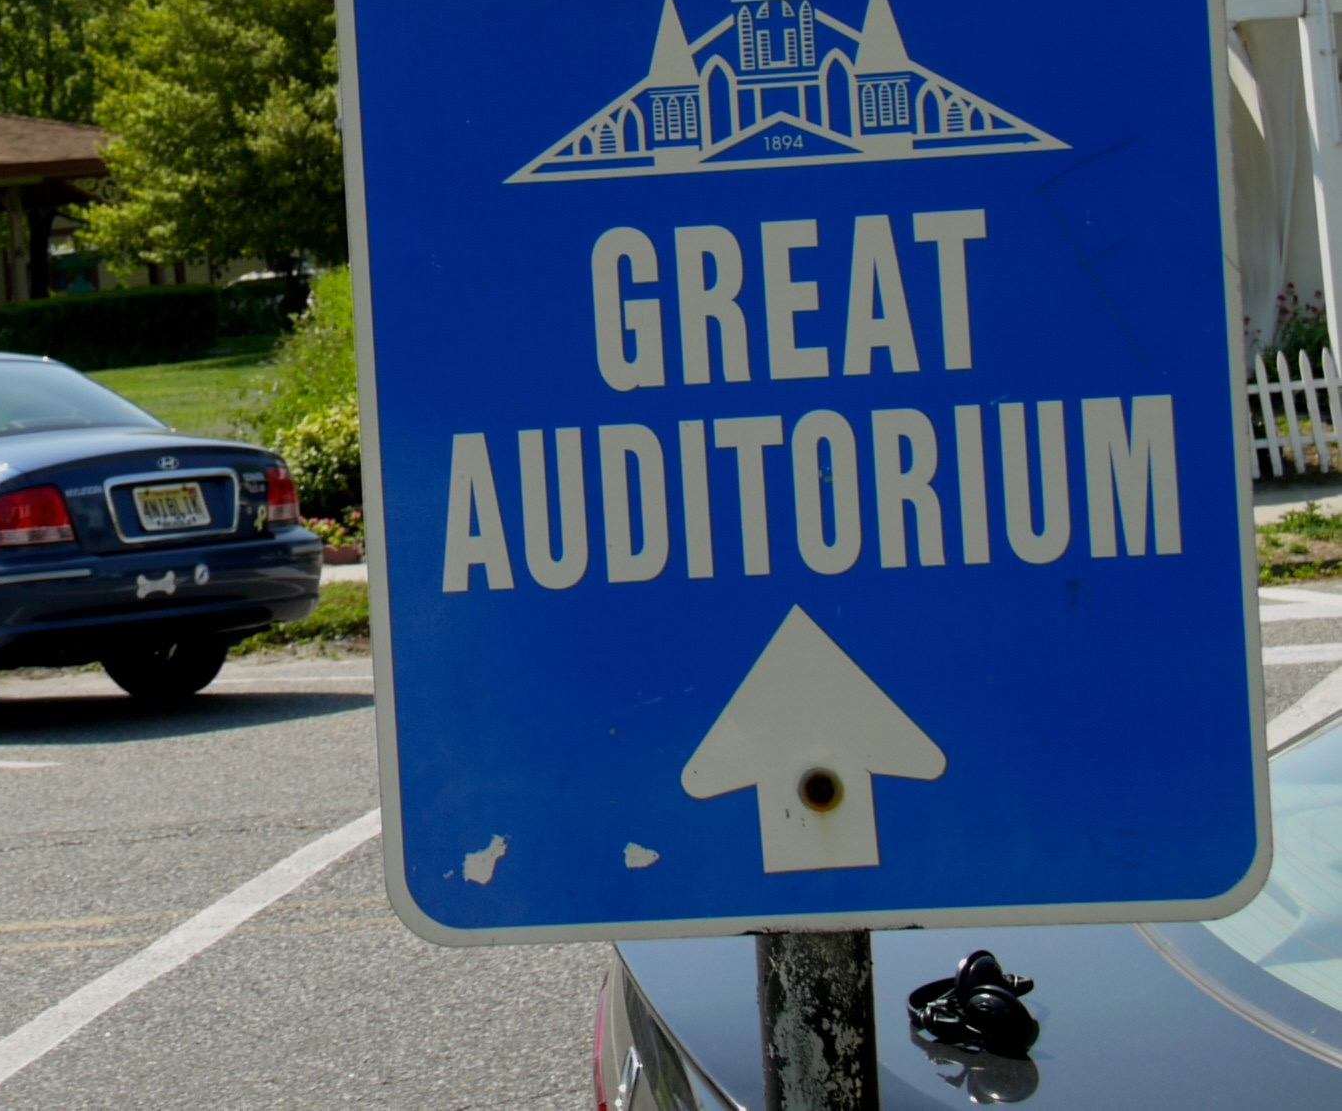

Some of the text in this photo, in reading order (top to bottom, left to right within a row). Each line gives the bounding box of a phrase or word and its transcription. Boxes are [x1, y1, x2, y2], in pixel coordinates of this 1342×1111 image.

[762, 134, 804, 152] 1894
[591, 209, 987, 393] GREAT
[442, 395, 1183, 593] AUDITORIUM
